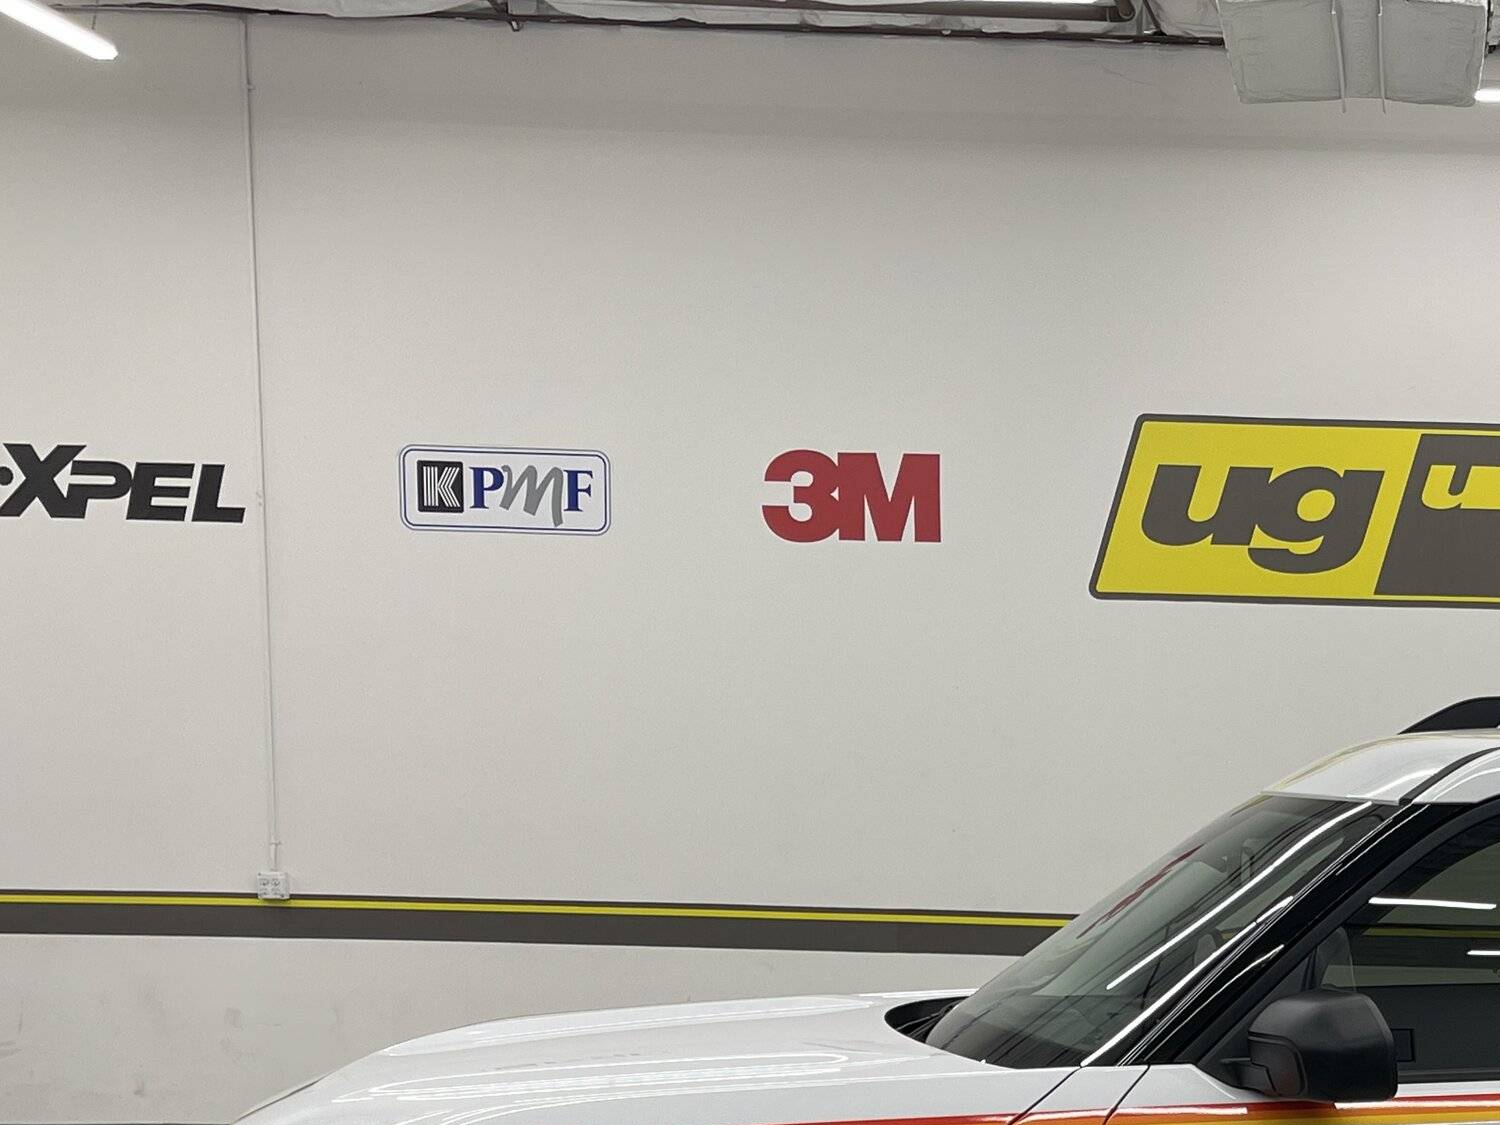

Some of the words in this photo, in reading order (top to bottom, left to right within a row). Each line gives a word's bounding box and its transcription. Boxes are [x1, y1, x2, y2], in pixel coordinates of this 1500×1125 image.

[0, 443, 246, 523] XPEL
[761, 449, 941, 543] 3M
[1141, 464, 1385, 574] ug
